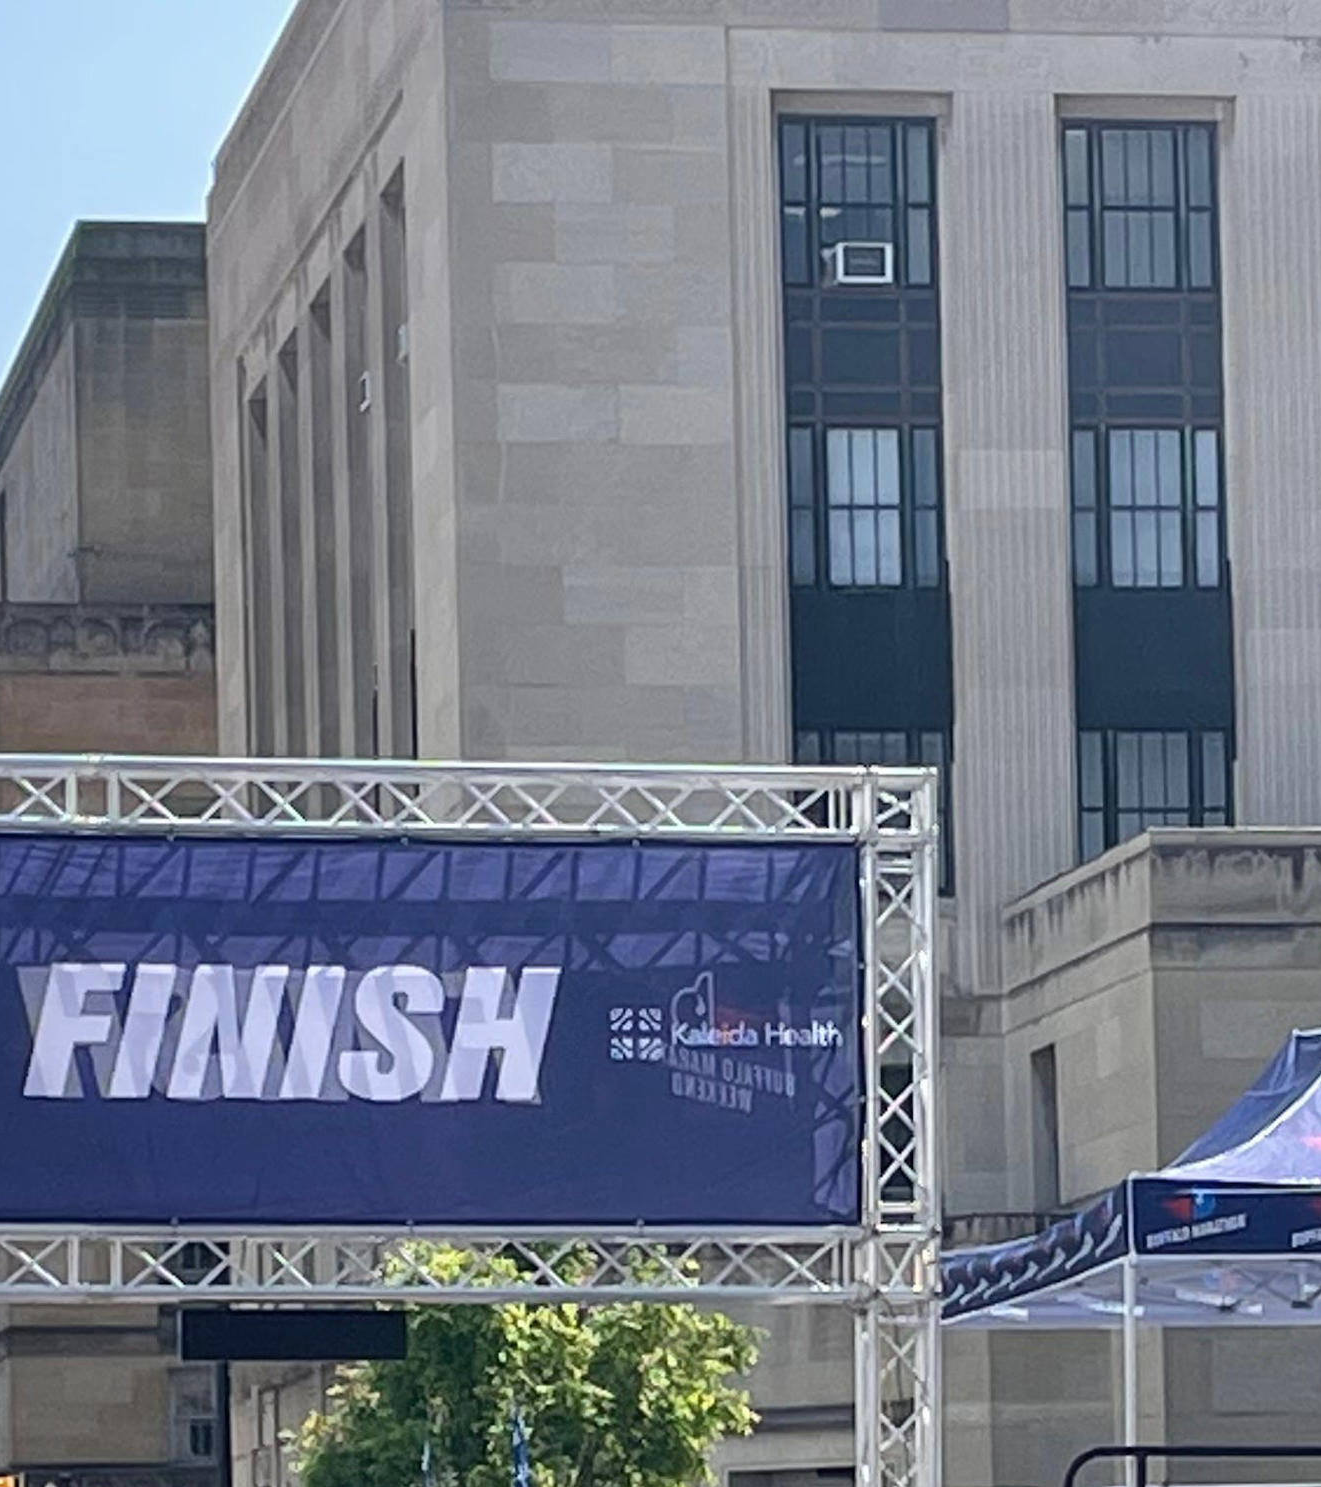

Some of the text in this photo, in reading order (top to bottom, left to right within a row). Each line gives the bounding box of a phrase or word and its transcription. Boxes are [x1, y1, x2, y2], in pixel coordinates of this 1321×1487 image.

[23, 962, 563, 1101] FINISH
[672, 1019, 845, 1048] Kaleida Health
